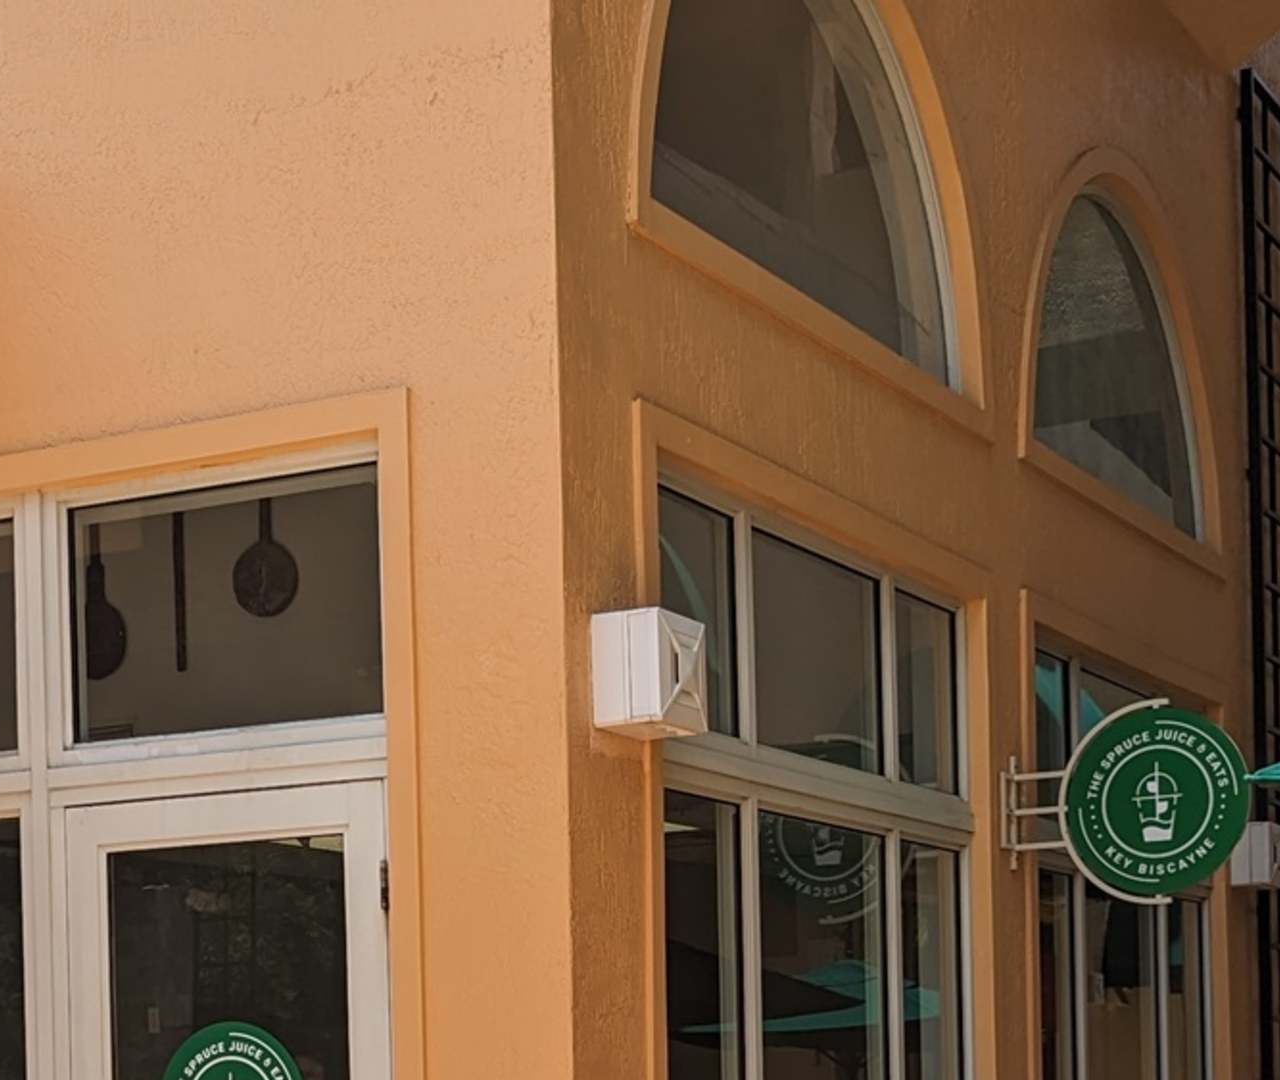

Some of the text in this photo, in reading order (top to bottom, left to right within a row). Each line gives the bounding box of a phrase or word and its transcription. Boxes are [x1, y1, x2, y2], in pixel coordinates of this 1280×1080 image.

[1086, 772, 1104, 801] THE
[1101, 730, 1151, 771] SPRUCE
[1154, 728, 1197, 747] JUICE
[1205, 754, 1230, 788] EATS
[1104, 837, 1216, 876] KEY BISCAYNE
[184, 1041, 226, 1077] SPRUCE
[228, 1041, 264, 1061] JUICE
